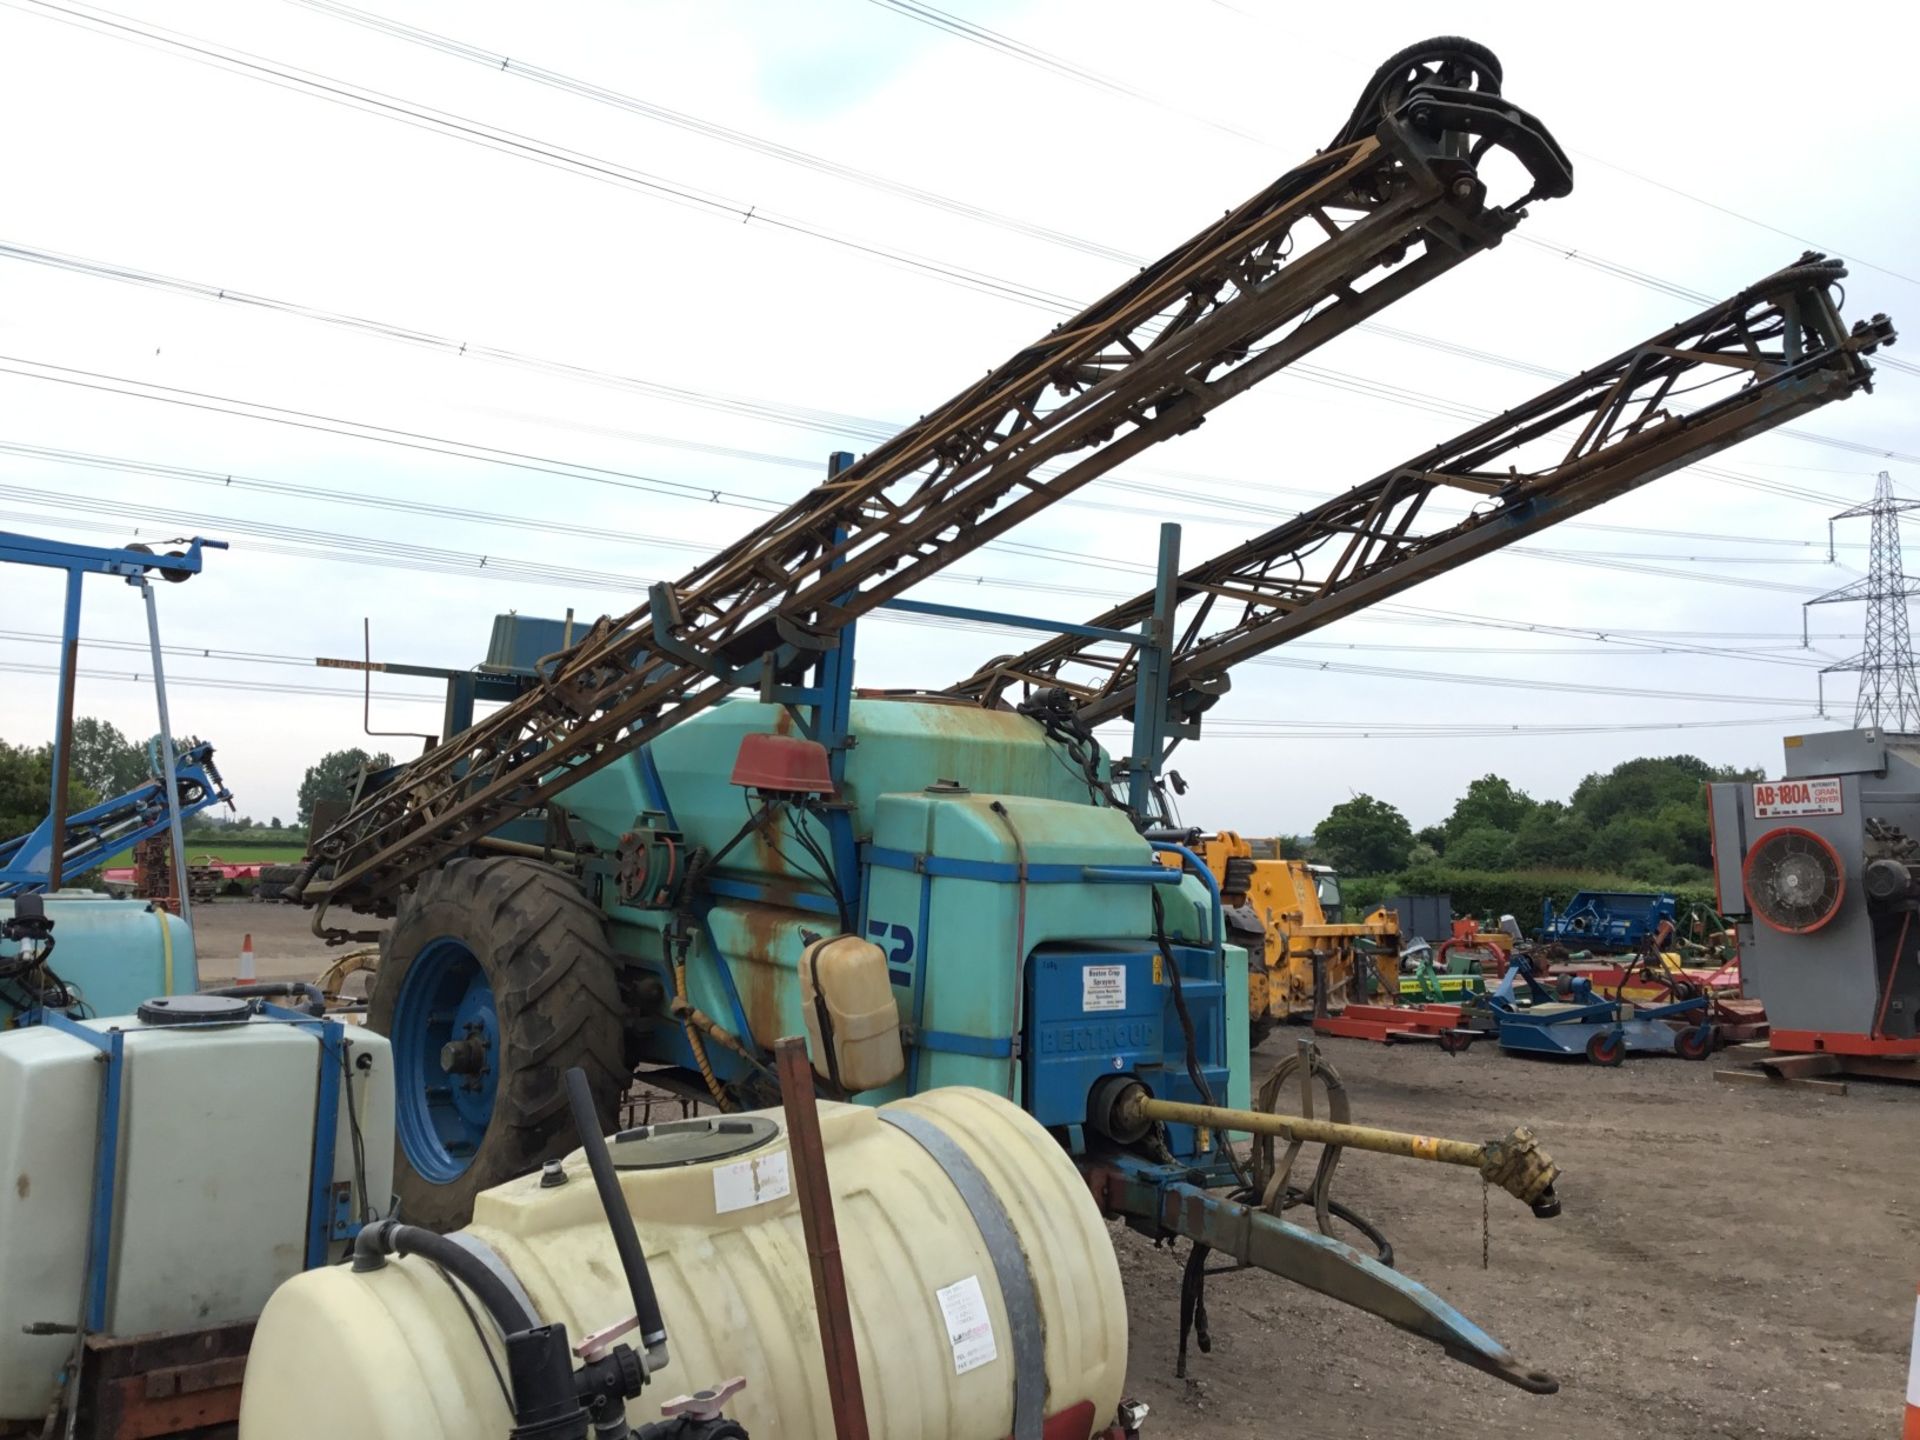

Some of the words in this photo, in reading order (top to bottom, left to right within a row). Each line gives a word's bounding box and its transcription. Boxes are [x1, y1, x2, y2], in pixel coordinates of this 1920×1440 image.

[1756, 783, 1811, 806] AB-180A
[1814, 788, 1839, 796] GRAIN
[1814, 795, 1840, 804] DRYER
[1041, 1023, 1153, 1054] BERTHOUD
